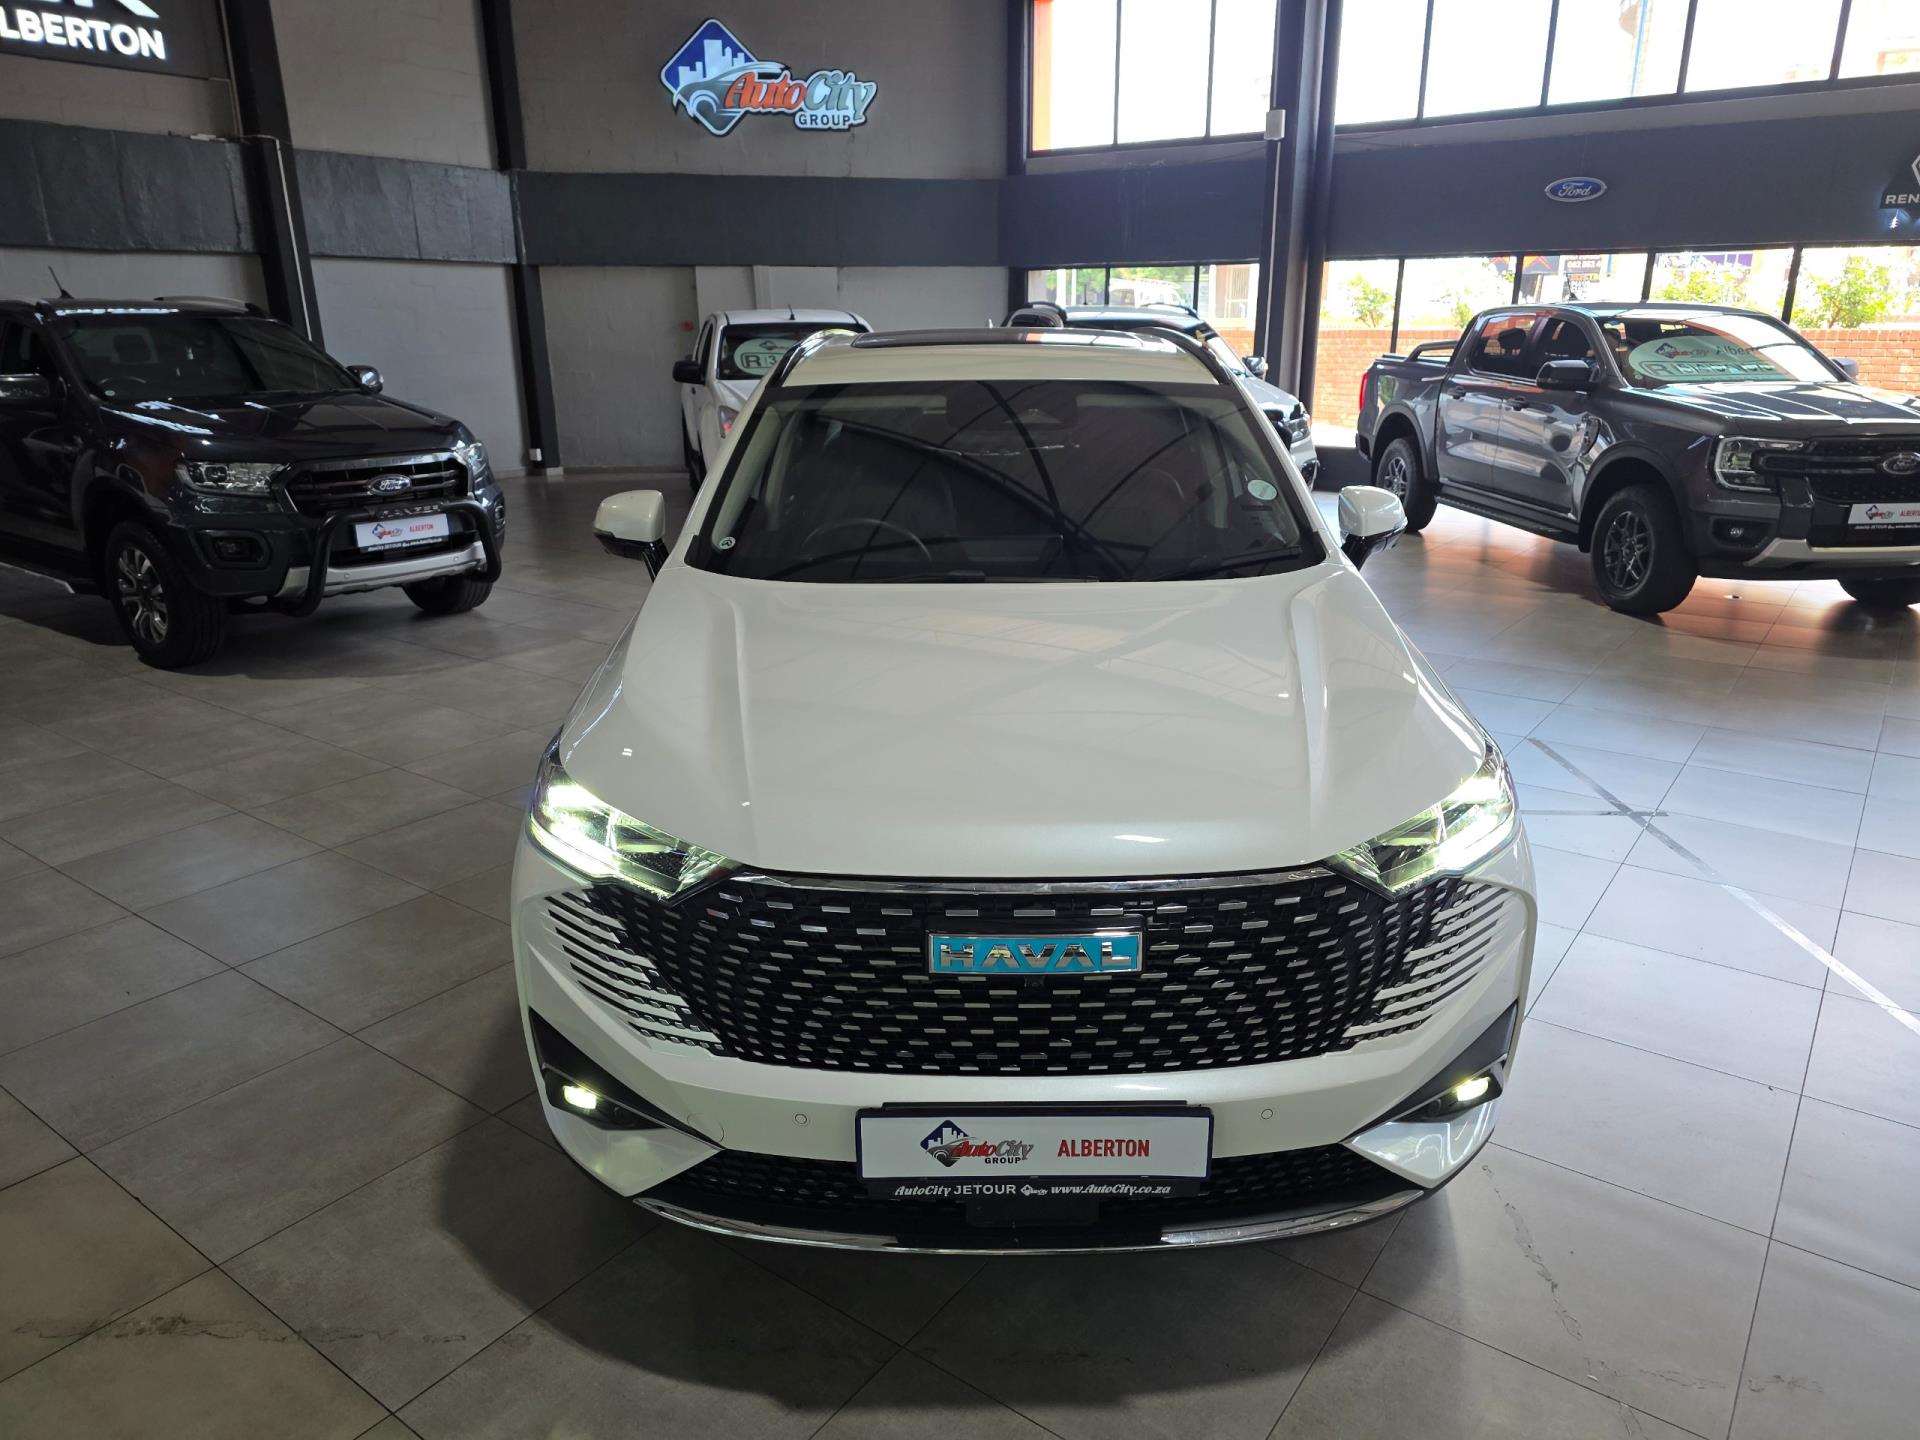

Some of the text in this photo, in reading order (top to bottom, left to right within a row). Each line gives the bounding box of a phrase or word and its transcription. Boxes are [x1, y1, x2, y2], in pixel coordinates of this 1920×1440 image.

[724, 71, 874, 121] AutoCity
[798, 113, 851, 126] GROUP
[1558, 182, 1592, 198] Ford
[744, 355, 761, 367] R
[939, 942, 1132, 968] HAVAL
[952, 1139, 1034, 1161] AutoCity
[1057, 1138, 1151, 1158] ALBERTON
[984, 1156, 1022, 1165] GROUP
[895, 1184, 951, 1197] AutoCity
[953, 1184, 1016, 1195] JETOUR
[1051, 1183, 1171, 1197] www.AutoCity.co.za
